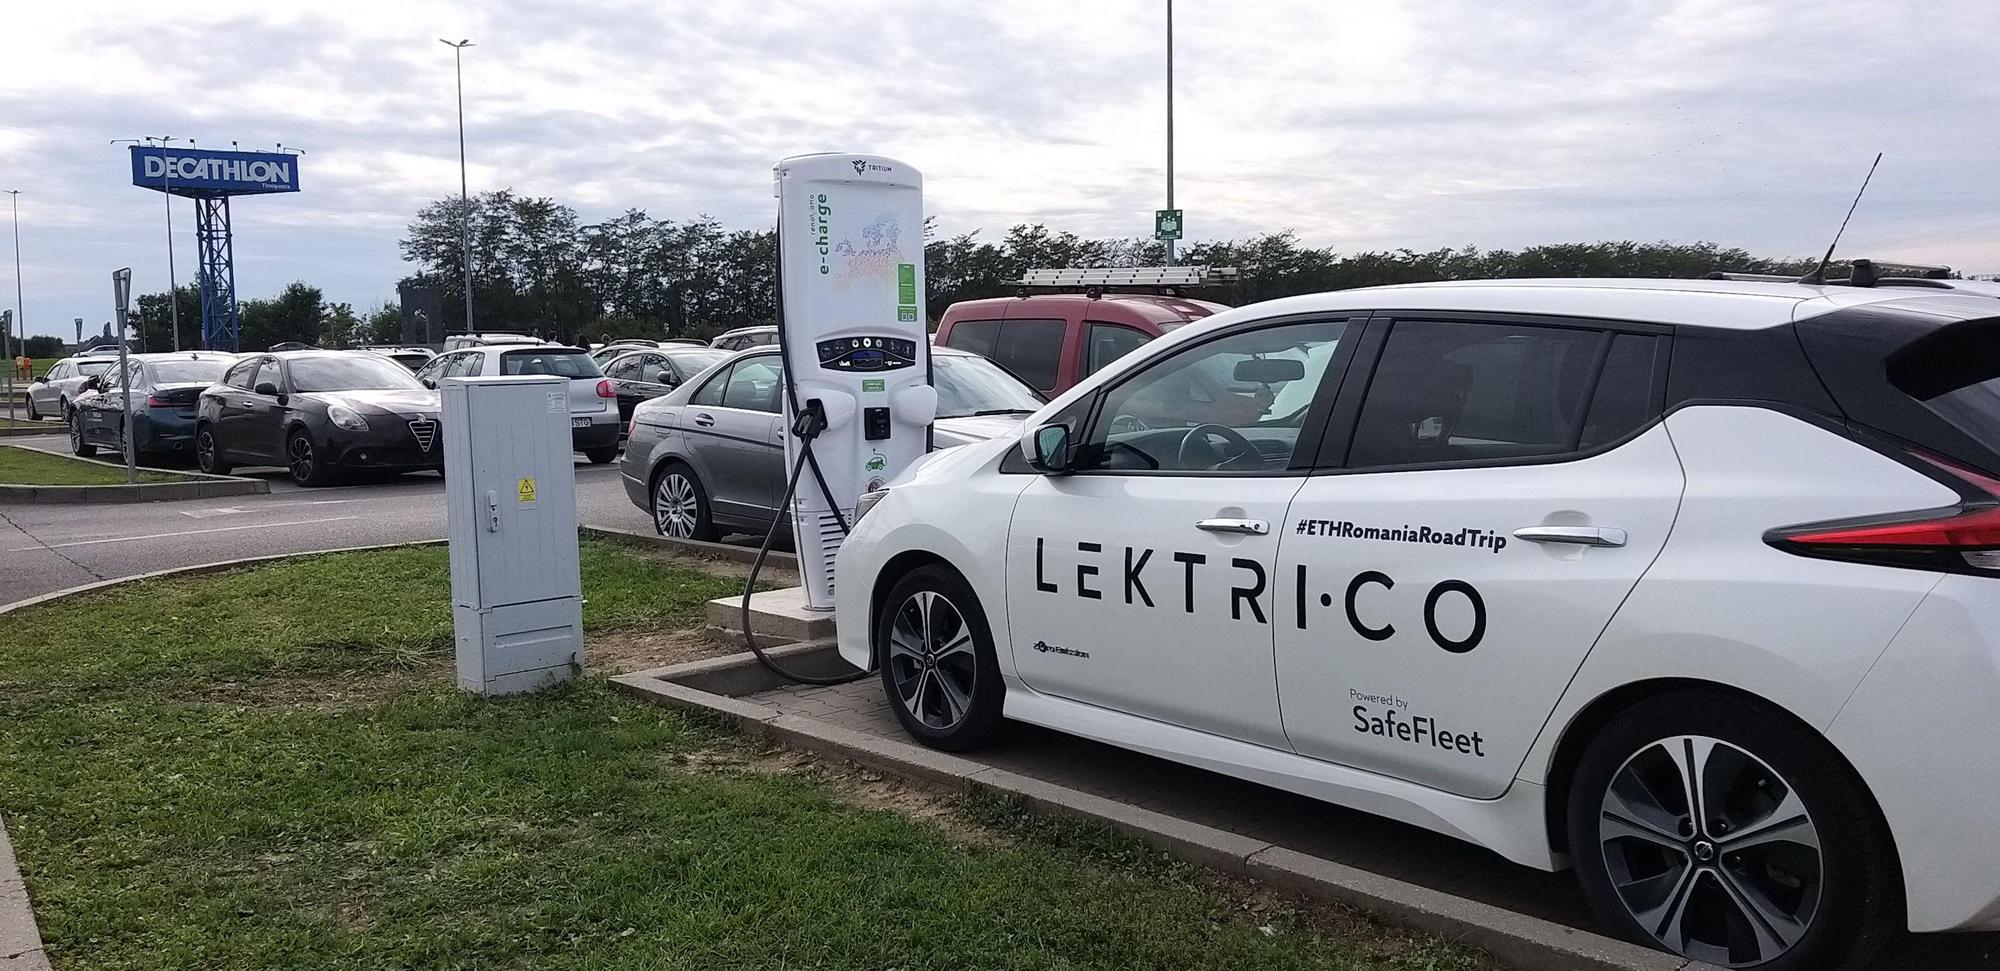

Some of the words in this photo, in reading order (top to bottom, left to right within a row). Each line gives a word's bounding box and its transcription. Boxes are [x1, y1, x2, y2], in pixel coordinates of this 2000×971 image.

[144, 155, 290, 183] DECATHLON
[868, 164, 892, 173] TRITIUM
[815, 193, 831, 275] e-charge
[1296, 519, 1507, 553] #ETHRomaniaRoadTrip
[1349, 688, 1394, 706] Powered
[1395, 696, 1409, 711] by
[1352, 705, 1485, 758] SafeFleet
